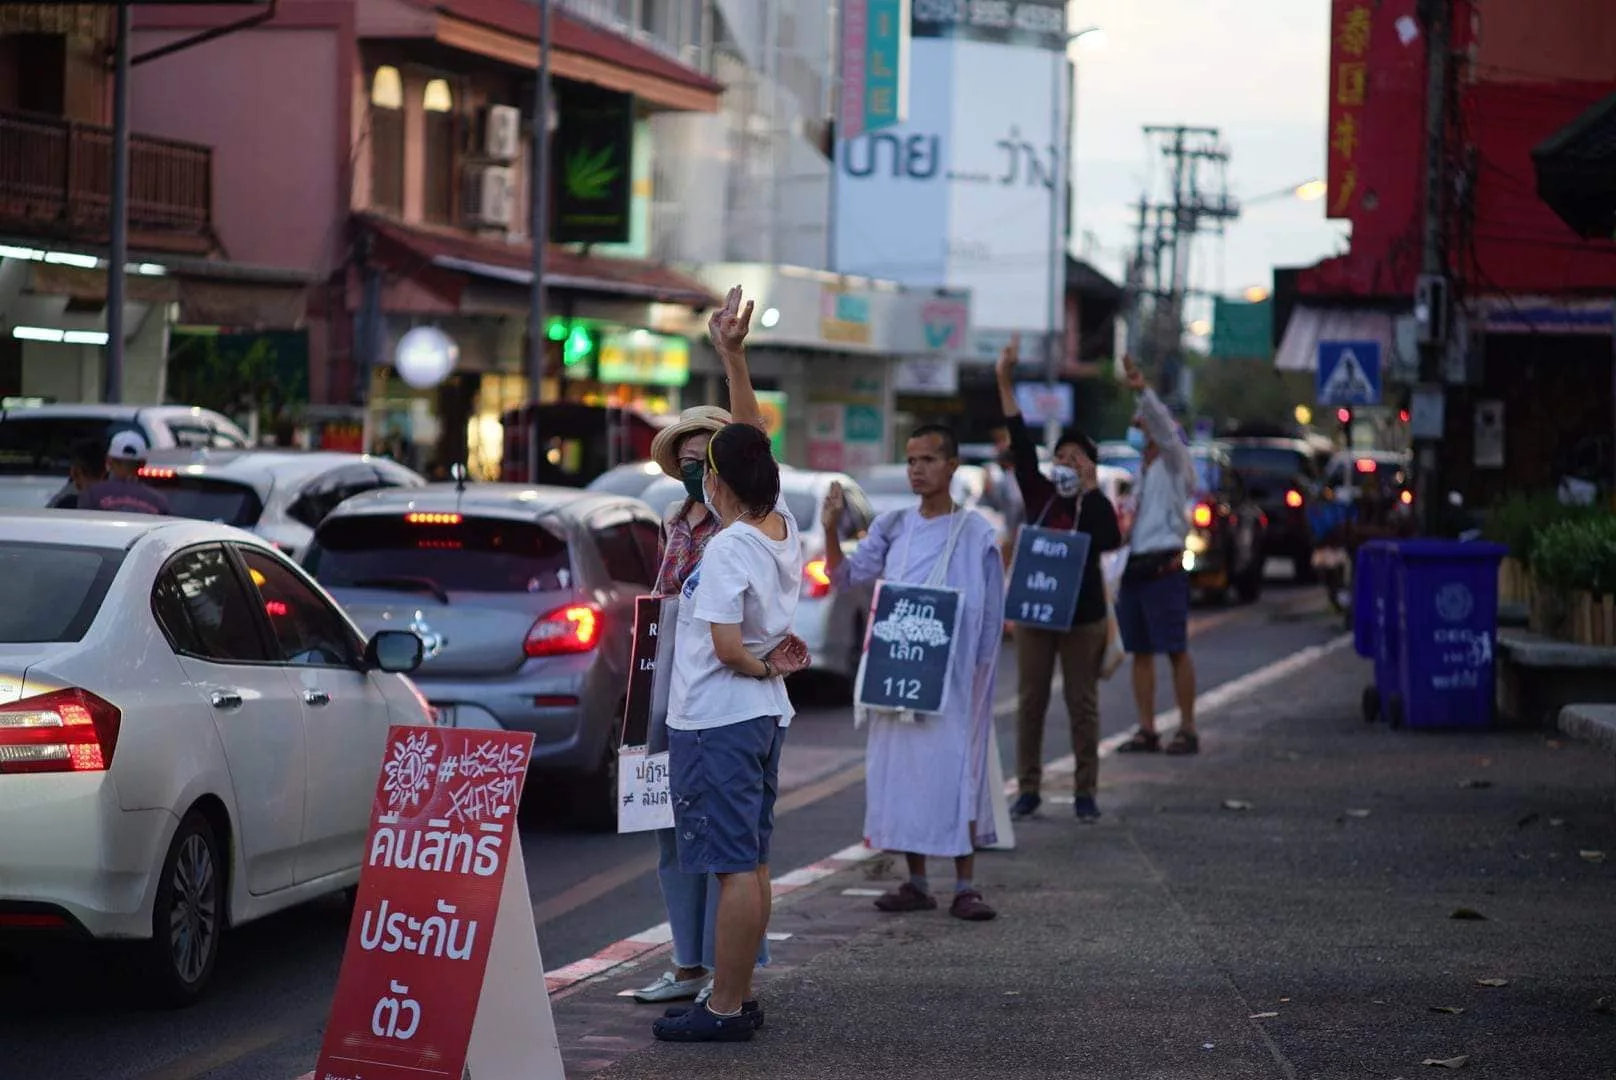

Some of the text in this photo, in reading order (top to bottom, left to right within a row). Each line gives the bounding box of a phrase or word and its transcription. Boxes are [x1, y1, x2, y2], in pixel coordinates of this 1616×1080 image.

[1020, 600, 1054, 623] 112
[883, 676, 922, 700] 112
[369, 805, 510, 877] คืนสิทธิ์
[360, 899, 477, 961] ประกัน
[371, 980, 421, 1040] ตัว
